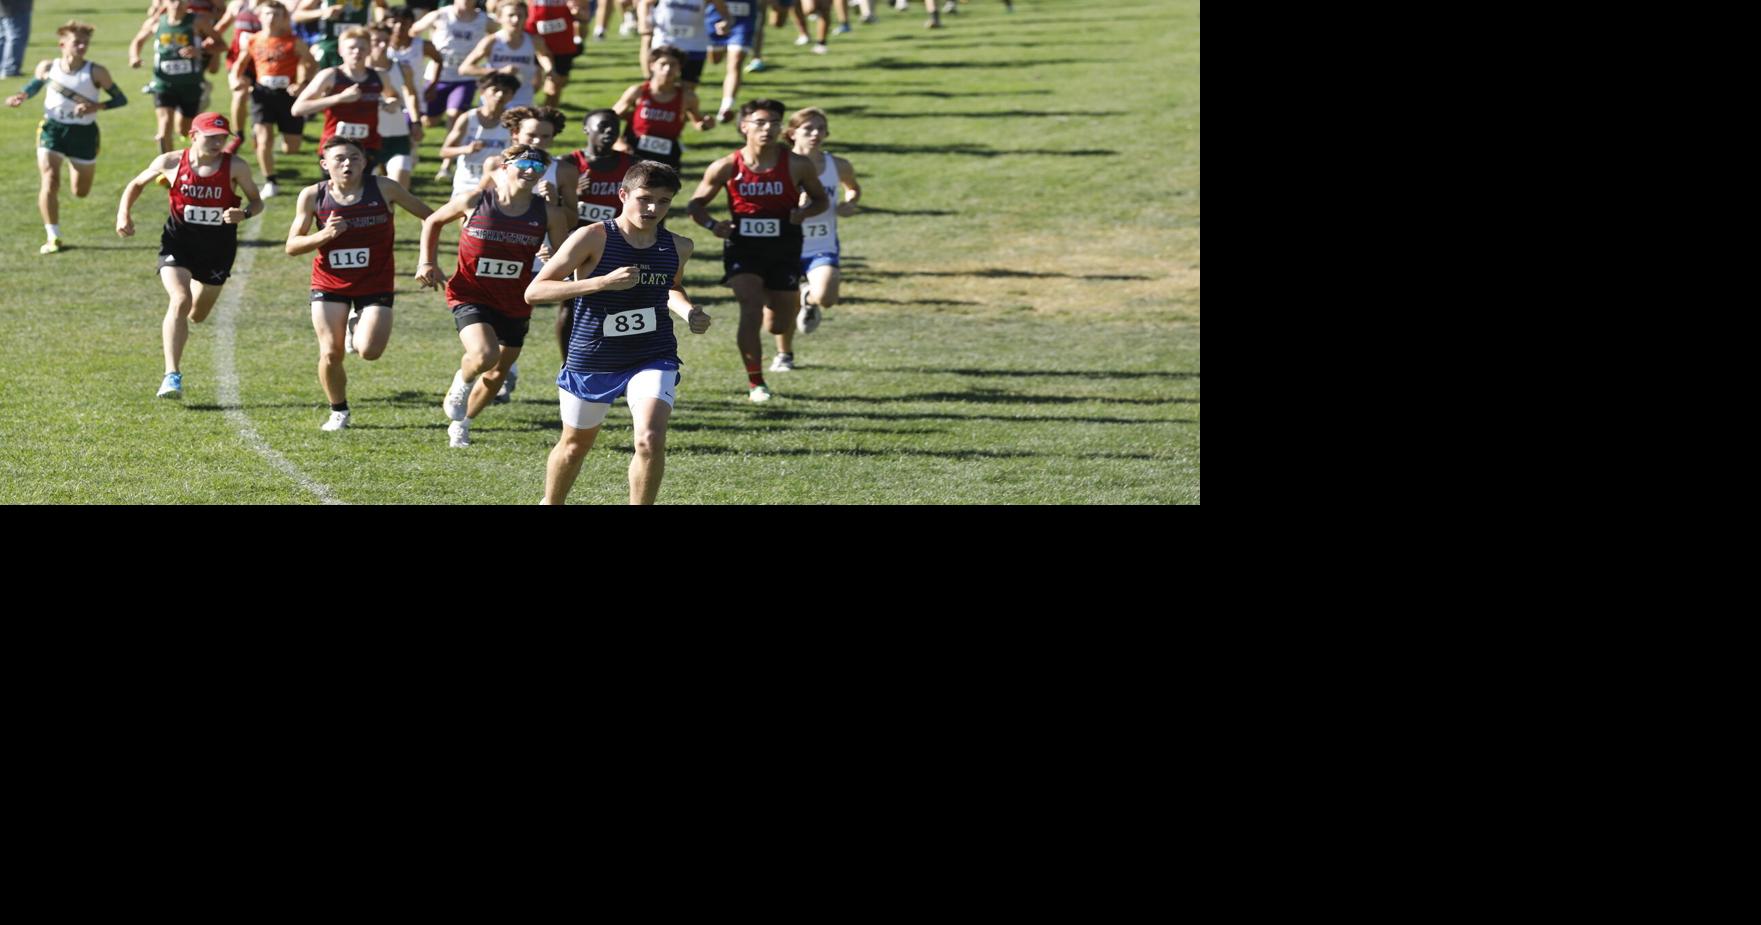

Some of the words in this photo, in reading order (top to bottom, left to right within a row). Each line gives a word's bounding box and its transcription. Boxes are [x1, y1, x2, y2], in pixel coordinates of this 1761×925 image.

[181, 184, 222, 199] COZAD
[740, 181, 783, 196] COZAD
[188, 209, 221, 222] 112
[580, 205, 612, 220] 105
[744, 221, 777, 234] 103
[808, 224, 828, 236] 73
[333, 251, 367, 266] 116
[480, 261, 519, 276] 119
[615, 313, 645, 332] 83
